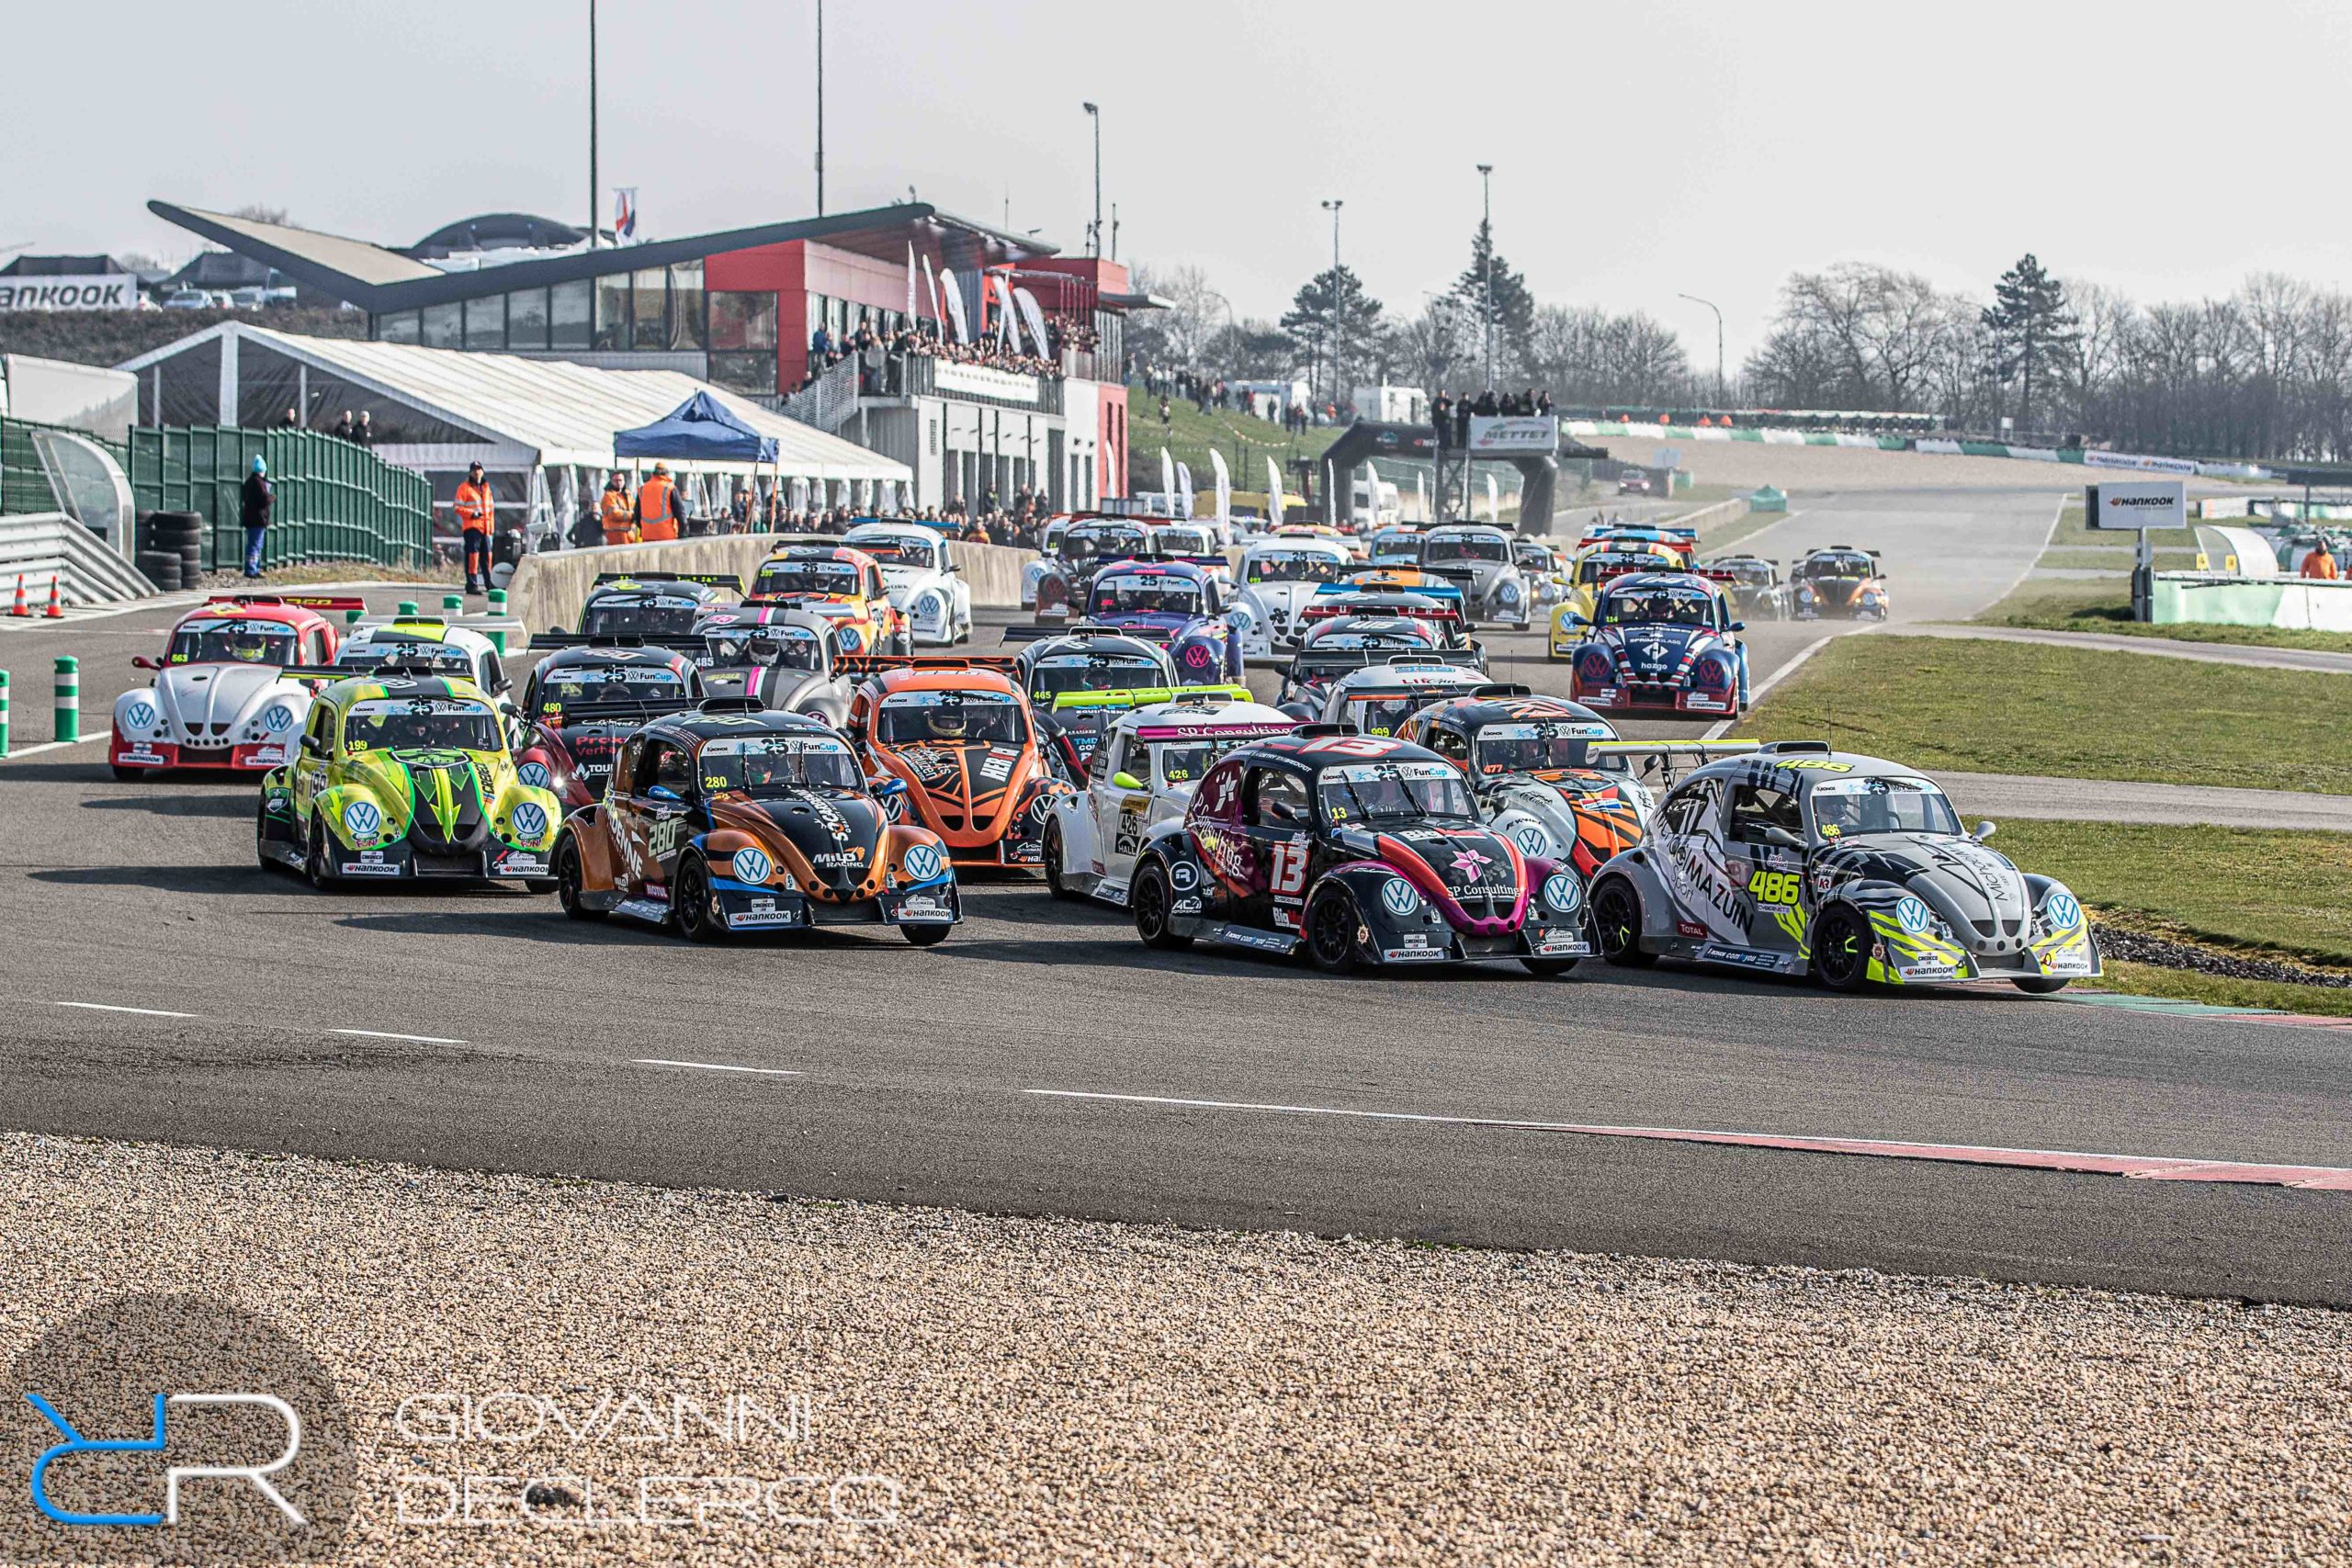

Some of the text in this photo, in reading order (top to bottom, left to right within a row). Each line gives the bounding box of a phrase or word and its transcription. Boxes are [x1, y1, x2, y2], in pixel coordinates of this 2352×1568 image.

[1484, 430, 1550, 439] METTET
[259, 624, 290, 634] FunCup
[781, 629, 810, 640] FunCup
[431, 648, 462, 657] FunCup
[172, 654, 188, 663] 563
[639, 672, 673, 682] FunCup
[1033, 691, 1052, 700] 465
[447, 704, 482, 715] FunCup
[543, 703, 562, 713] 480
[1371, 728, 1390, 737] 999
[1571, 727, 1604, 737] FunCup
[347, 739, 368, 751] 199
[803, 742, 839, 752] FunCup
[1168, 770, 1190, 780] 426
[1414, 768, 1448, 778] FunCup
[705, 776, 728, 788] 280
[1330, 807, 1348, 819] 13
[1121, 814, 1139, 836] 426
[1821, 824, 1840, 837] 486
[648, 818, 678, 858] 280
[1118, 844, 1137, 855] HALL
[354, 864, 396, 873] HANKOOK
[1270, 840, 1311, 895] 13
[646, 885, 668, 897] MOTUL
[1447, 884, 1521, 897] SP Consulting
[1748, 871, 1801, 904] 486
[913, 909, 951, 918] HANKOOK
[1680, 924, 1703, 935] TOTAL
[1552, 943, 1587, 953] HANKOOK
[1398, 950, 1442, 959] HANKOOK
[1914, 965, 1954, 976] HANKOOK
[2057, 962, 2089, 970] HANKOOK
